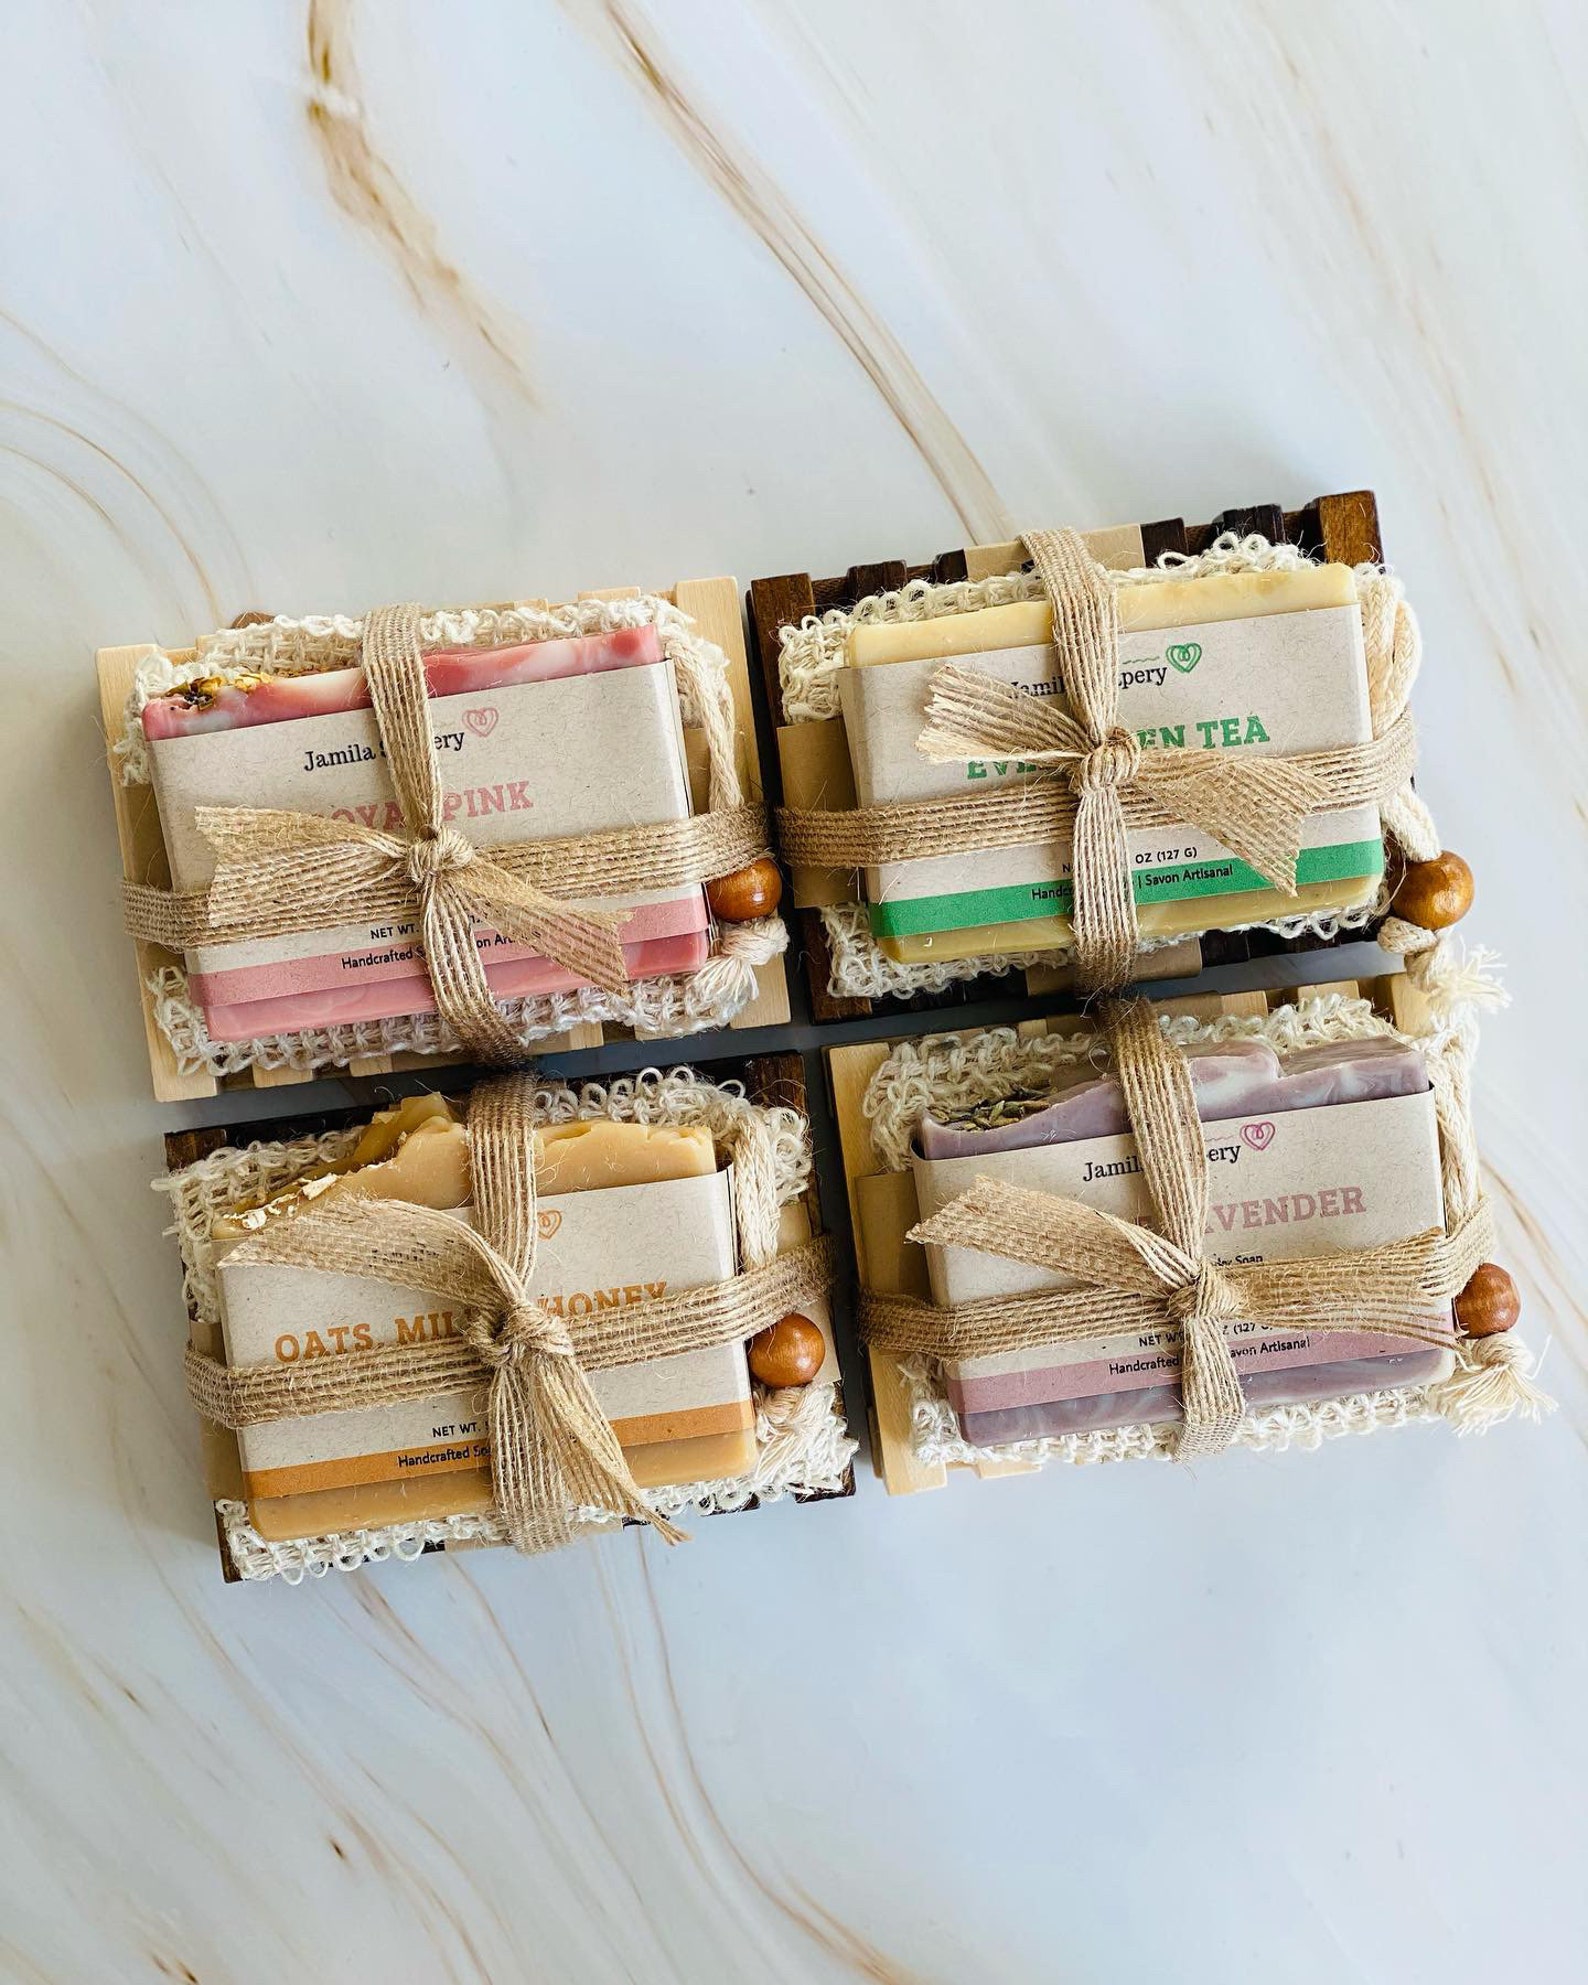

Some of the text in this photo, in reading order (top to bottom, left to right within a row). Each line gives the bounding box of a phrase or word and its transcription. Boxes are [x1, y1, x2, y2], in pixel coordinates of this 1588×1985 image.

[1196, 715, 1270, 749] TEA
[303, 743, 376, 772] Jamila
[442, 780, 534, 822] PINK
[1135, 846, 1198, 864] OZ (127 G)
[1145, 873, 1180, 886] Savon
[1183, 864, 1233, 880] Artisanal
[370, 923, 420, 940] NET WT.
[341, 949, 414, 970] Handcrafted
[1139, 1335, 1162, 1347] NET
[1233, 1322, 1256, 1335] (127
[1109, 1356, 1179, 1375] Handcrafted
[1260, 1336, 1310, 1354] Artisanal
[432, 1425, 455, 1438] NET
[459, 1422, 481, 1434] WT.
[397, 1446, 470, 1468] Handcrafted
